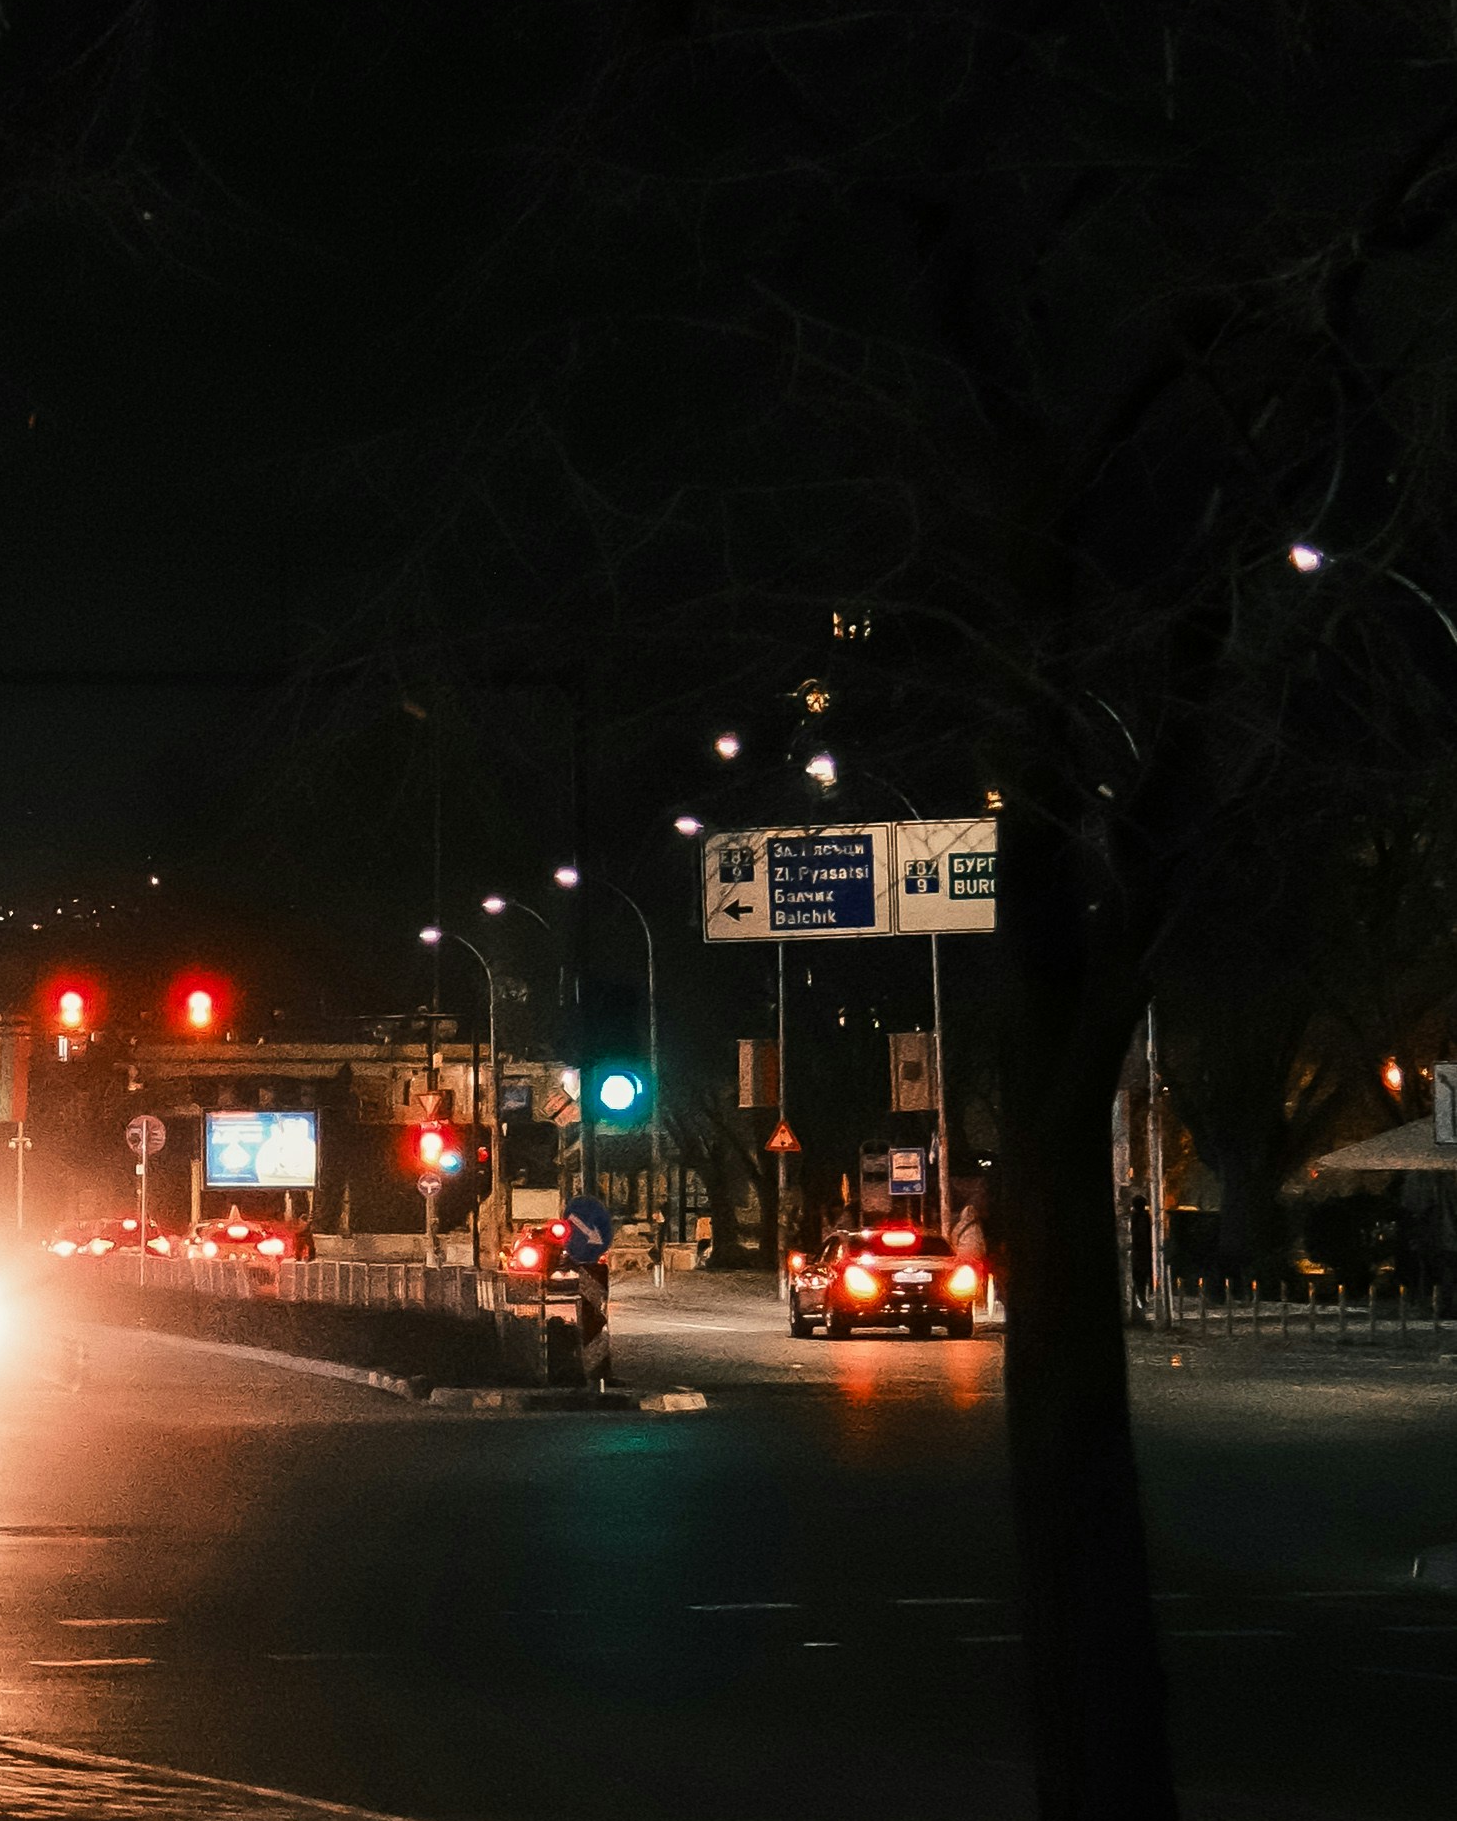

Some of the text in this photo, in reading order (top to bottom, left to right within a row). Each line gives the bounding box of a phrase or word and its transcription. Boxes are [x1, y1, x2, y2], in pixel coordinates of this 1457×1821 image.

[774, 864, 870, 884] Zl. Pyasatsi
[916, 878, 928, 893] 9
[774, 889, 835, 904] Балчик
[775, 909, 837, 925] Balchik
